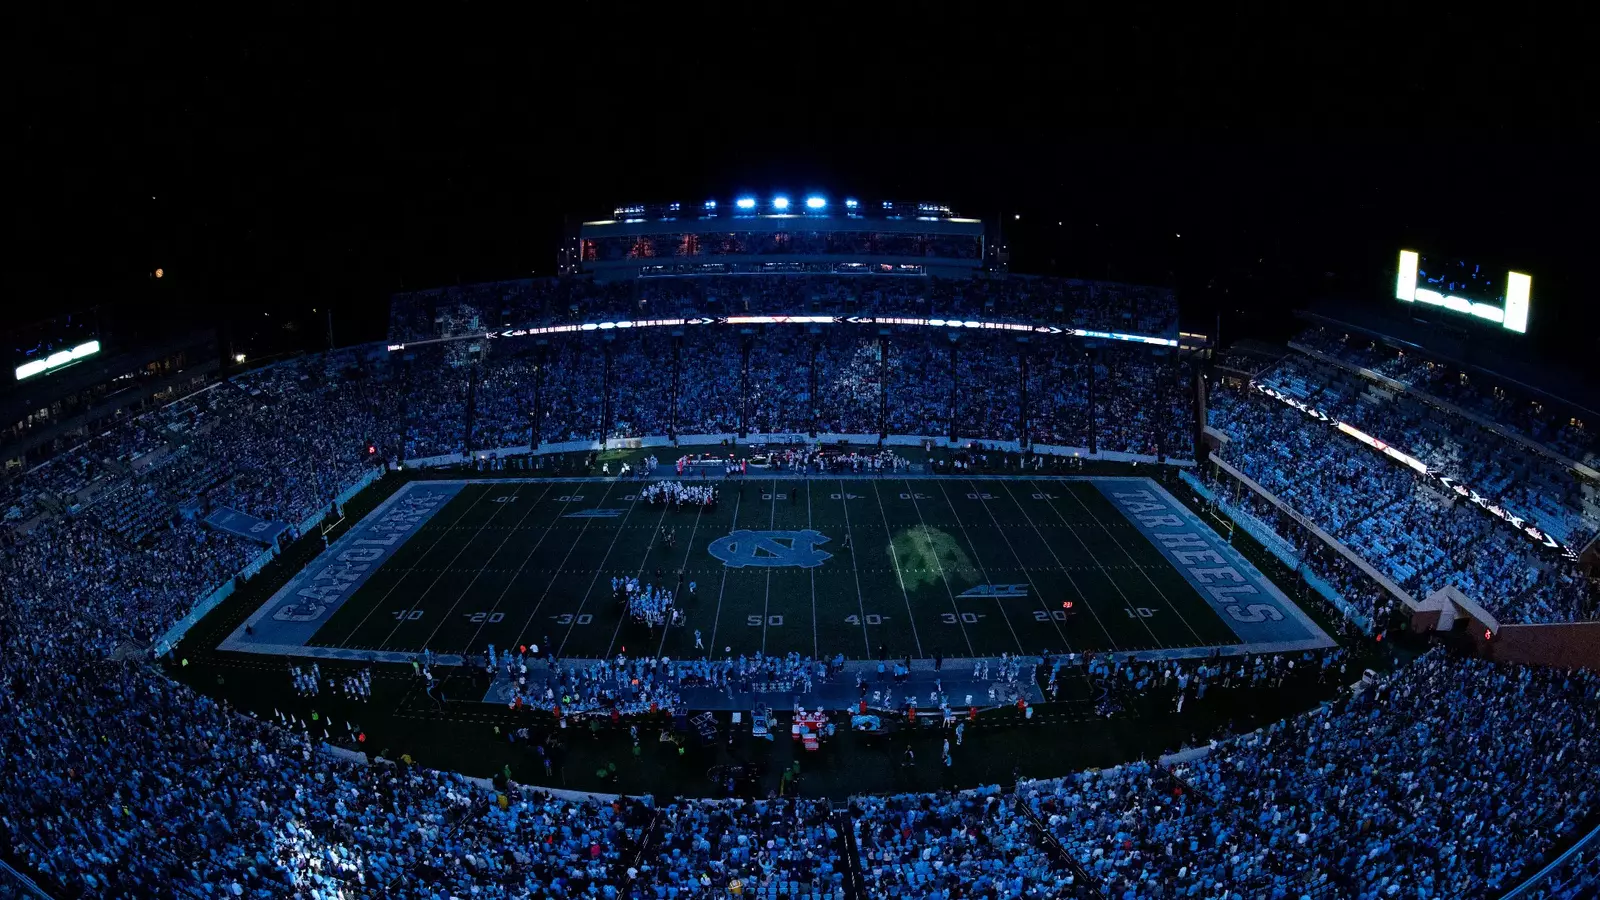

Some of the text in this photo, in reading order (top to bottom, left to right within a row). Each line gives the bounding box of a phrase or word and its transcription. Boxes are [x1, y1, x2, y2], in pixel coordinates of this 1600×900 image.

[1110, 489, 1286, 623] TAR HEELS
[395, 609, 424, 620] 10
[469, 612, 505, 623] 20
[941, 612, 978, 624] 30
[1033, 610, 1067, 621] 20
[1124, 607, 1153, 618] 10
[557, 613, 594, 625] 30
[747, 614, 784, 626] 50
[844, 614, 883, 626] 40
